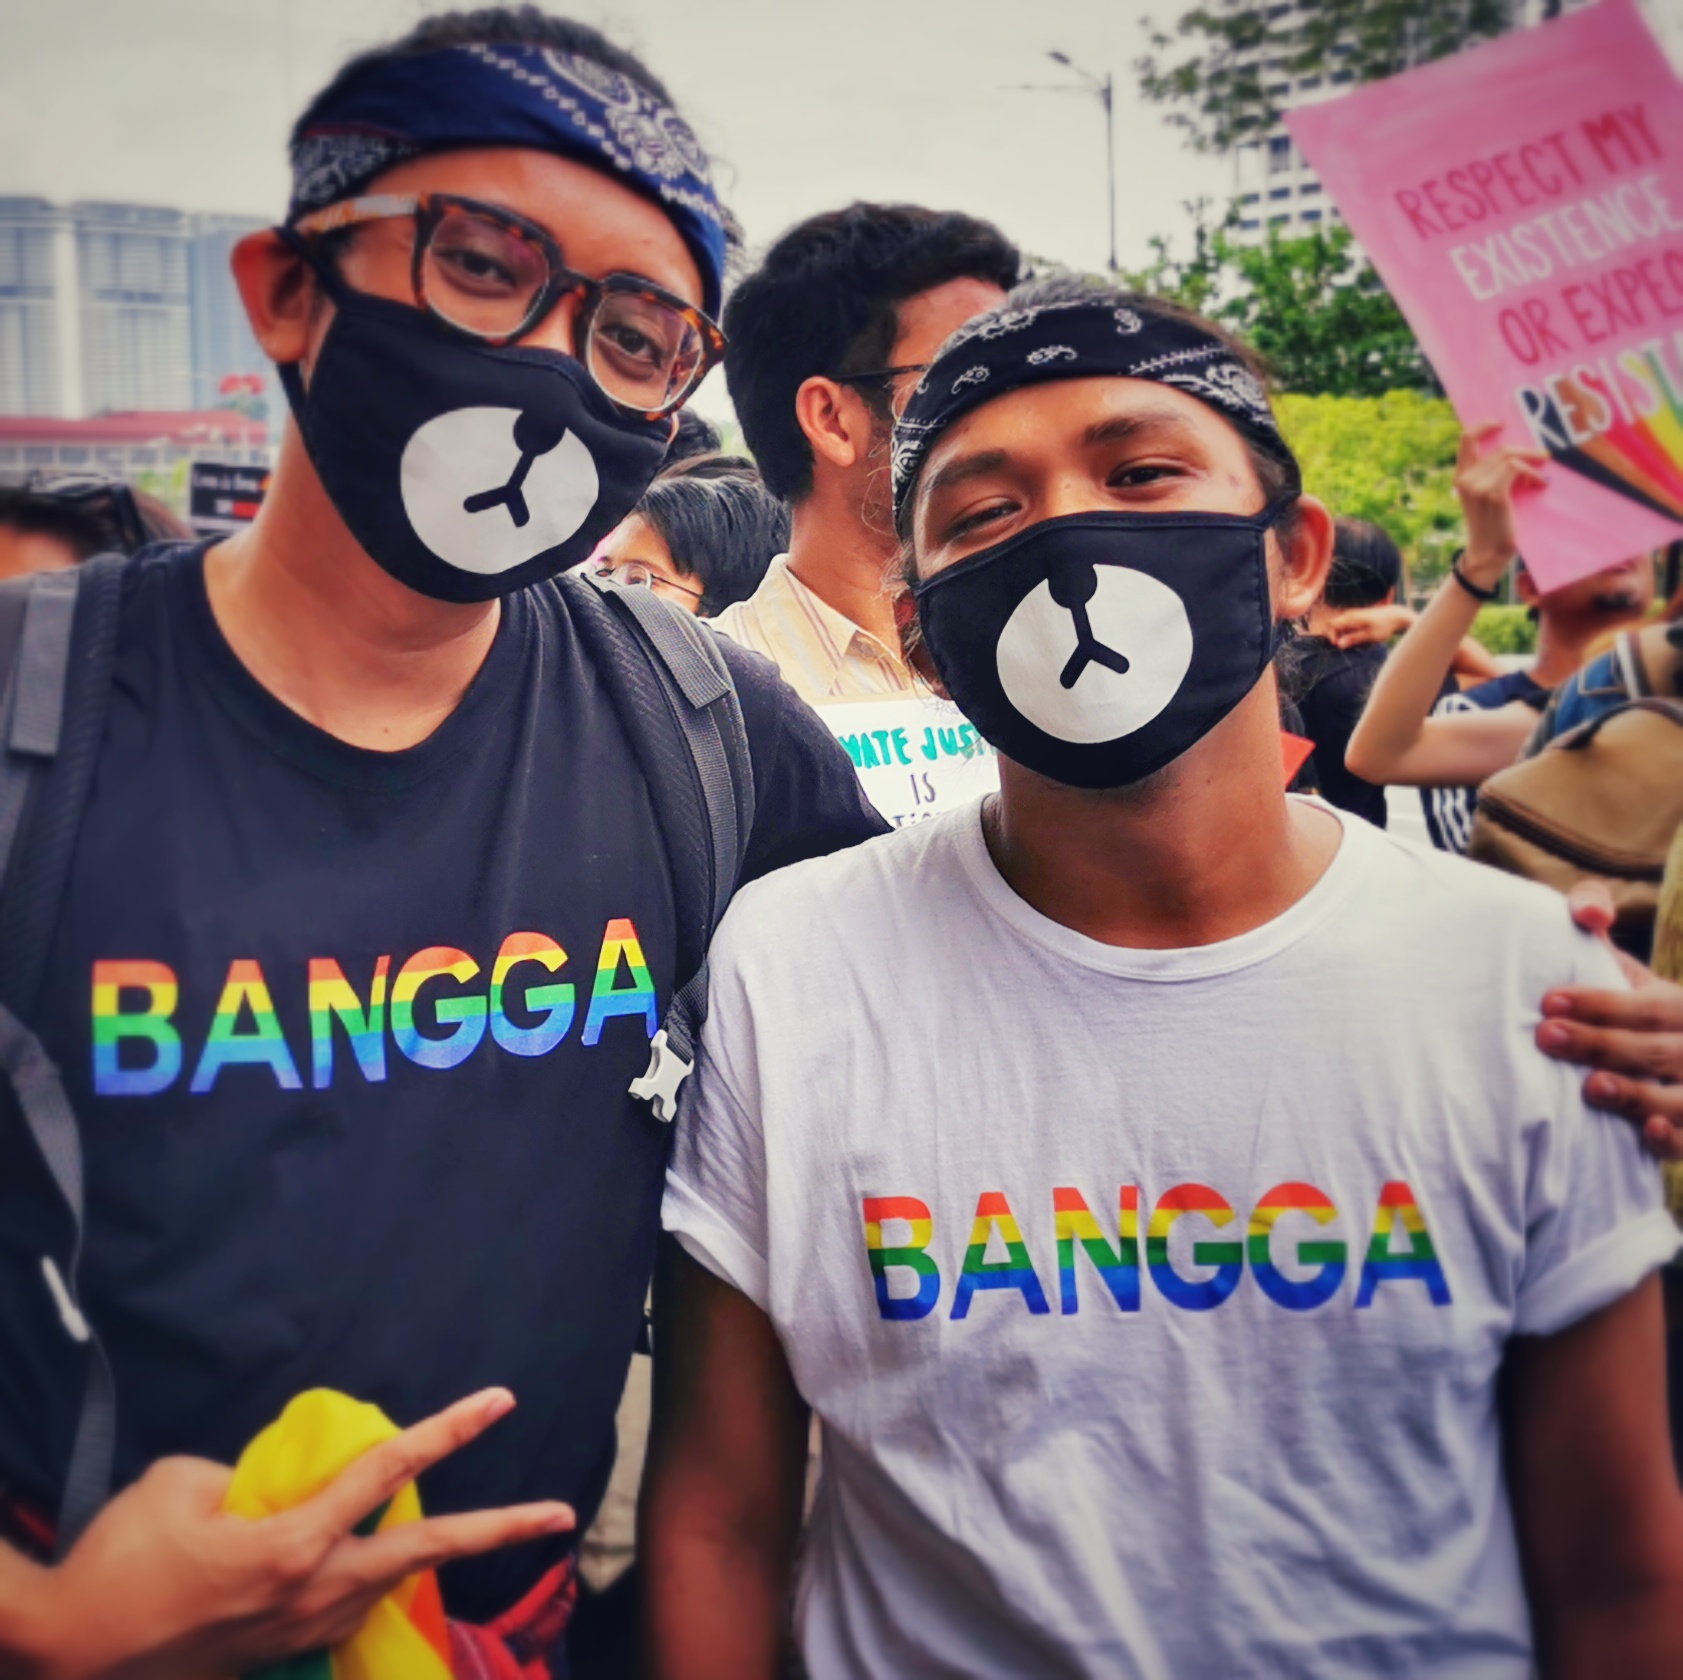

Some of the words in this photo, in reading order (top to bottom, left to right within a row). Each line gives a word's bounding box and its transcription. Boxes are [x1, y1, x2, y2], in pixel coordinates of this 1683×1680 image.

[1394, 130, 1585, 241] RESPECT
[1579, 102, 1664, 175] MY
[1449, 172, 1683, 301] EXISTENCE
[1498, 298, 1570, 366] OR
[1514, 329, 1683, 452] RESIST
[909, 771, 937, 805] IS
[91, 918, 659, 1096] BANGGA
[863, 1181, 1454, 1321] BANGGA
